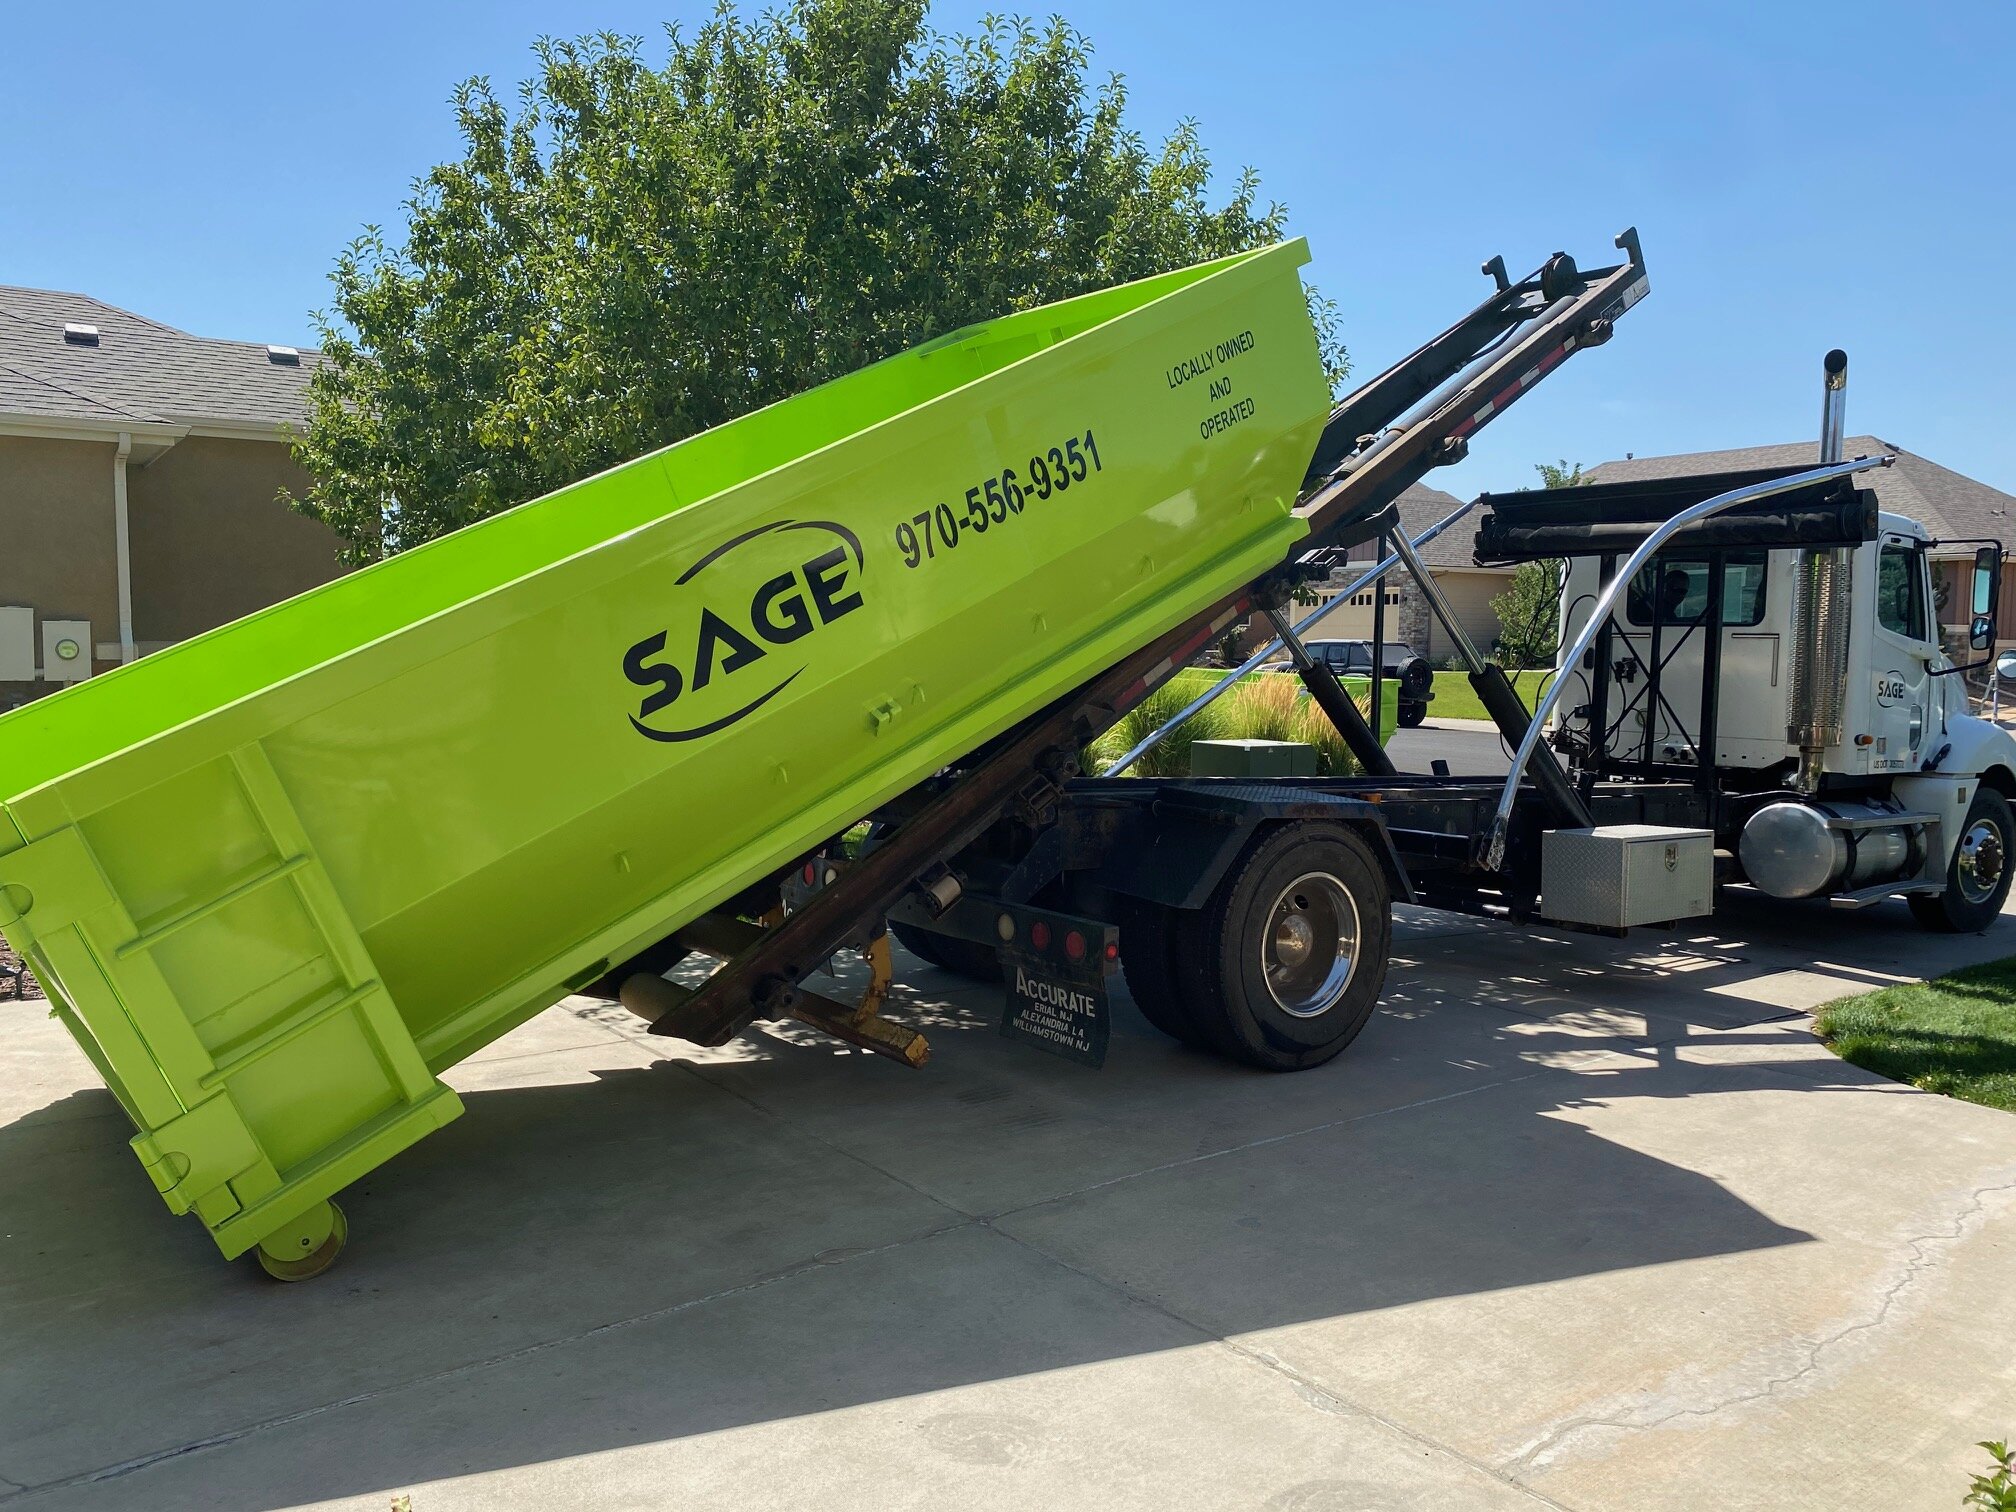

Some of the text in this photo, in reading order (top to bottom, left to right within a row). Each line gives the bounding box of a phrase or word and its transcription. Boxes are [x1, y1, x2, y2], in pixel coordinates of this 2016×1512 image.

[1166, 330, 1255, 389] LOCALLY OWNED
[1209, 376, 1232, 402] AND
[1200, 397, 1255, 440] OPERATED
[895, 429, 1103, 569] 970-556-9351
[622, 545, 865, 719] SAGE
[1878, 681, 1904, 699] SAGE
[1016, 967, 1096, 1018] ACCURATE
[1075, 1040, 1090, 1052] NJ
